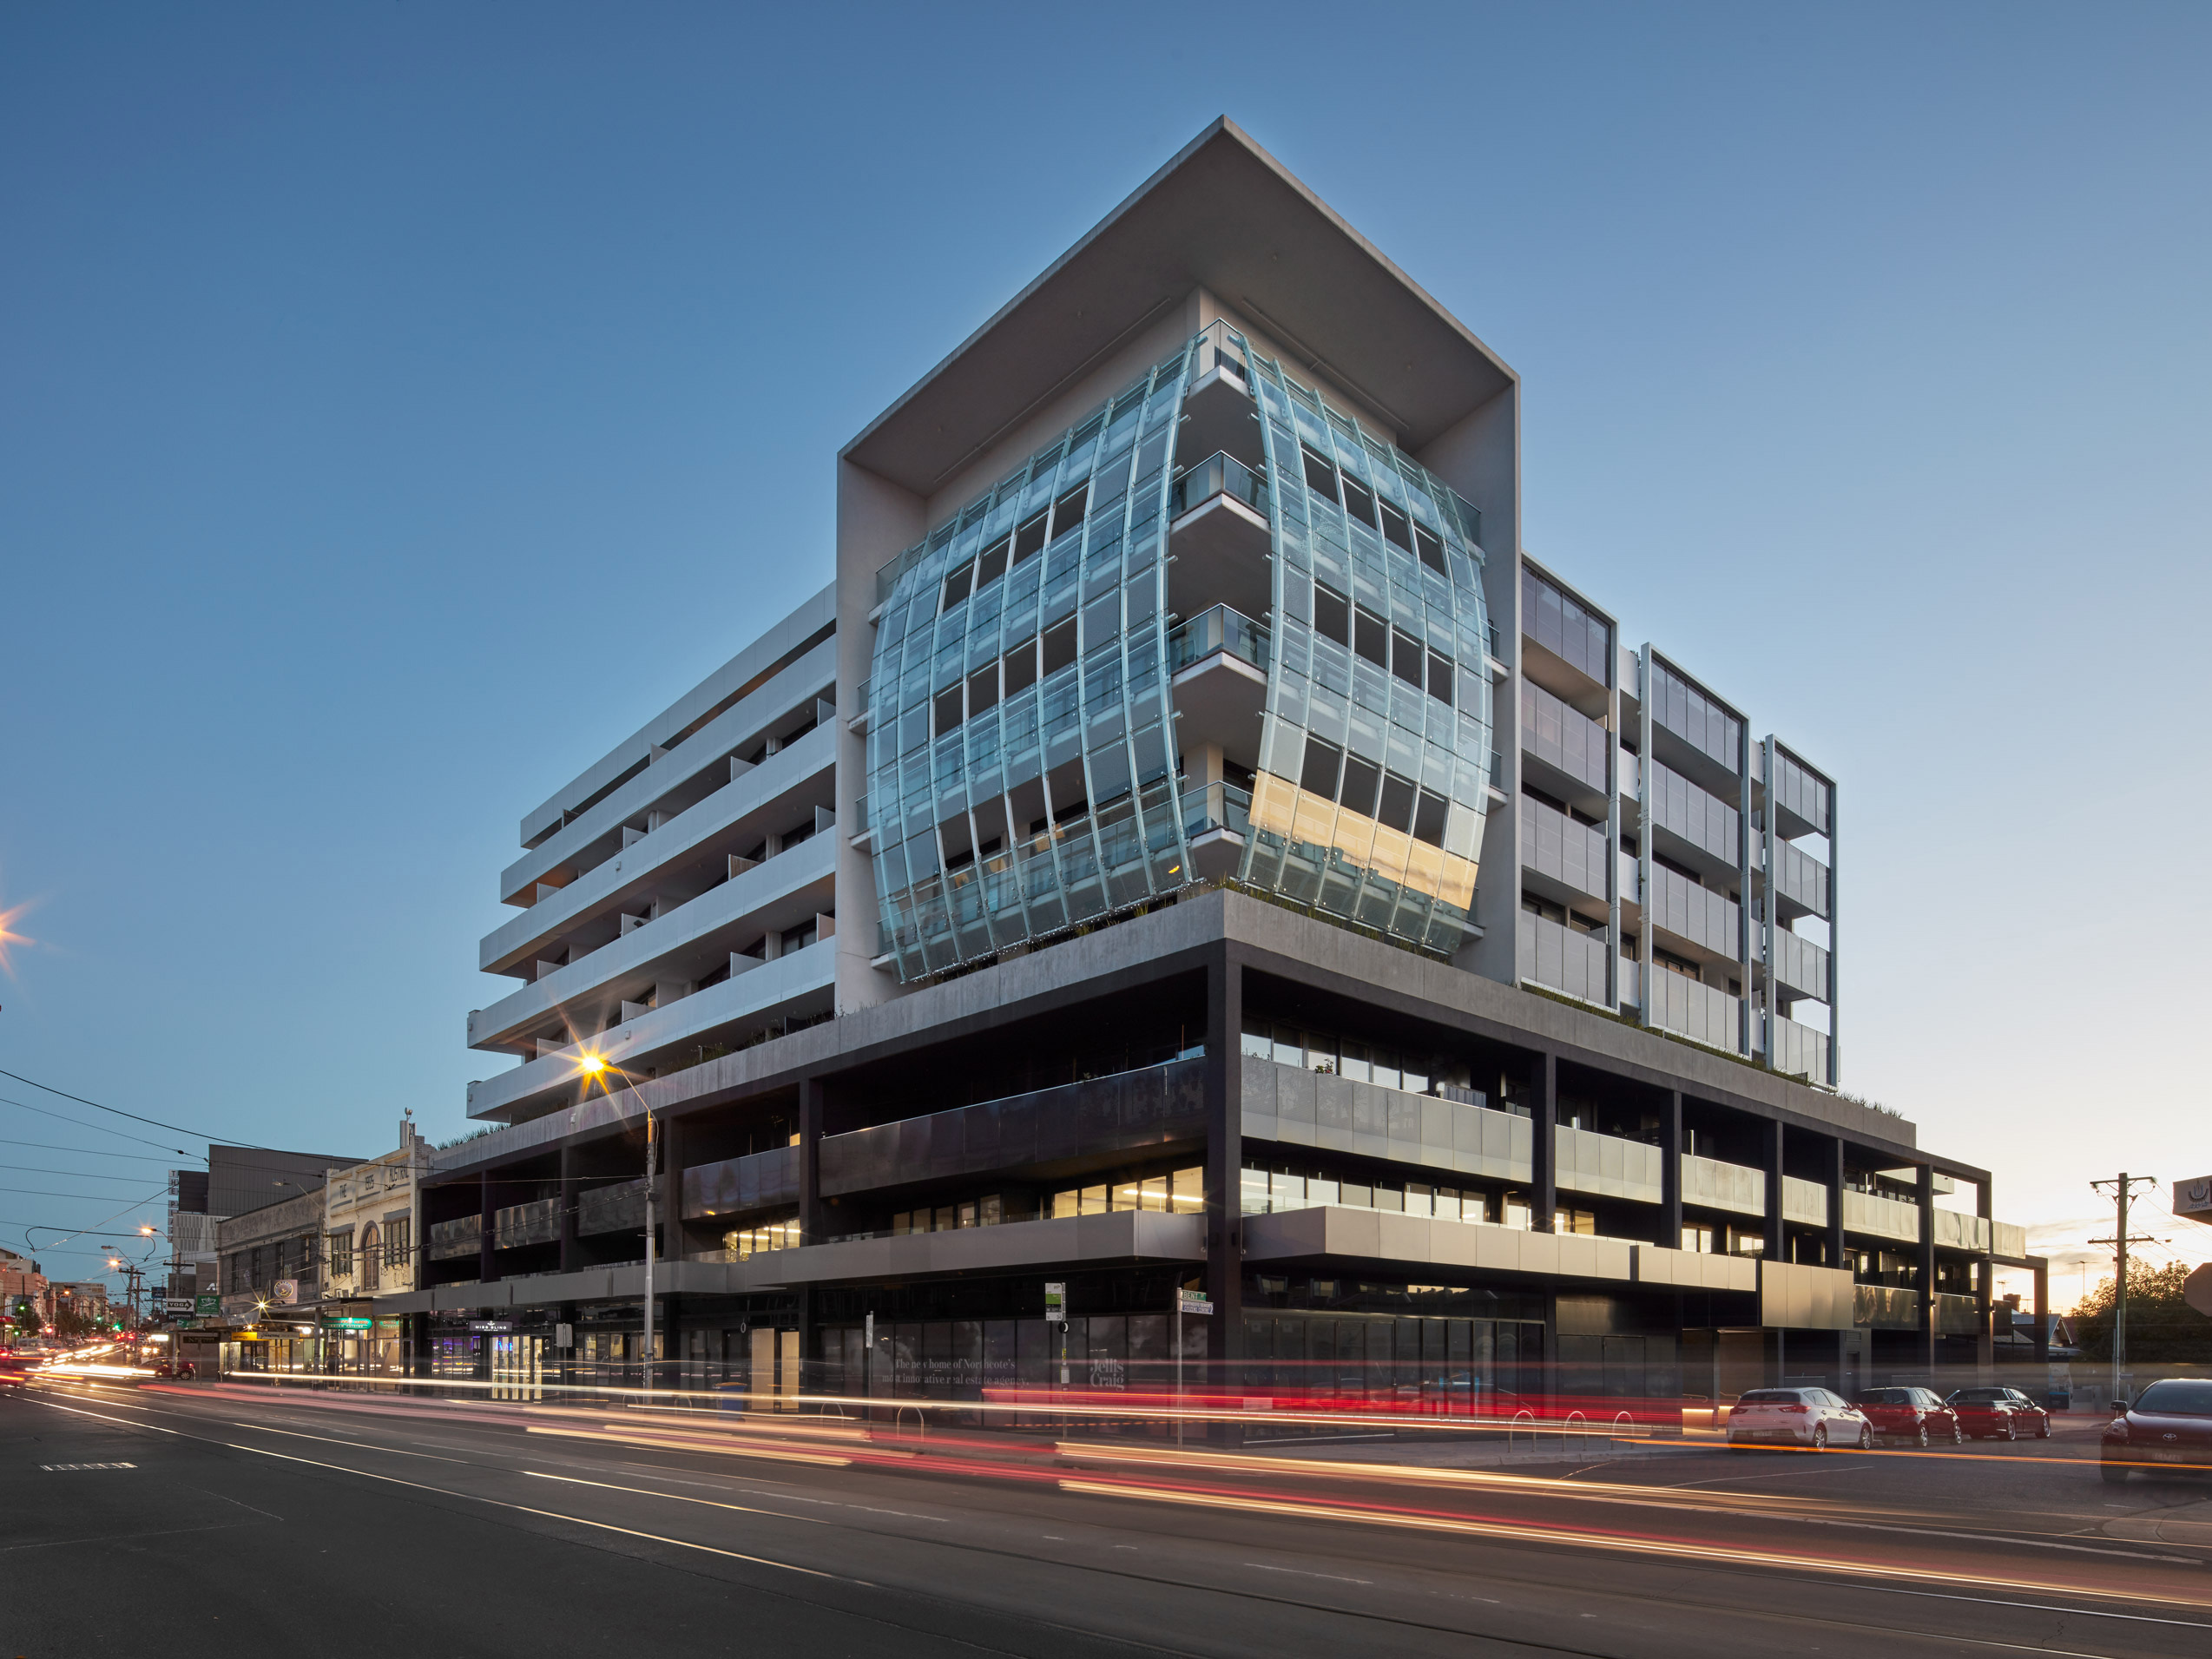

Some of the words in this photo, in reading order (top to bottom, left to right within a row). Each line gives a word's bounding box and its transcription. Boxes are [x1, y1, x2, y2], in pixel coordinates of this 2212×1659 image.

[1183, 1291, 1198, 1300] BENT
[895, 1359, 910, 1369] The
[929, 1359, 951, 1369] home
[952, 1359, 963, 1369] of
[1090, 1358, 1124, 1373] Jellis
[903, 1373, 945, 1384] innoative
[1090, 1373, 1125, 1392] Craig
